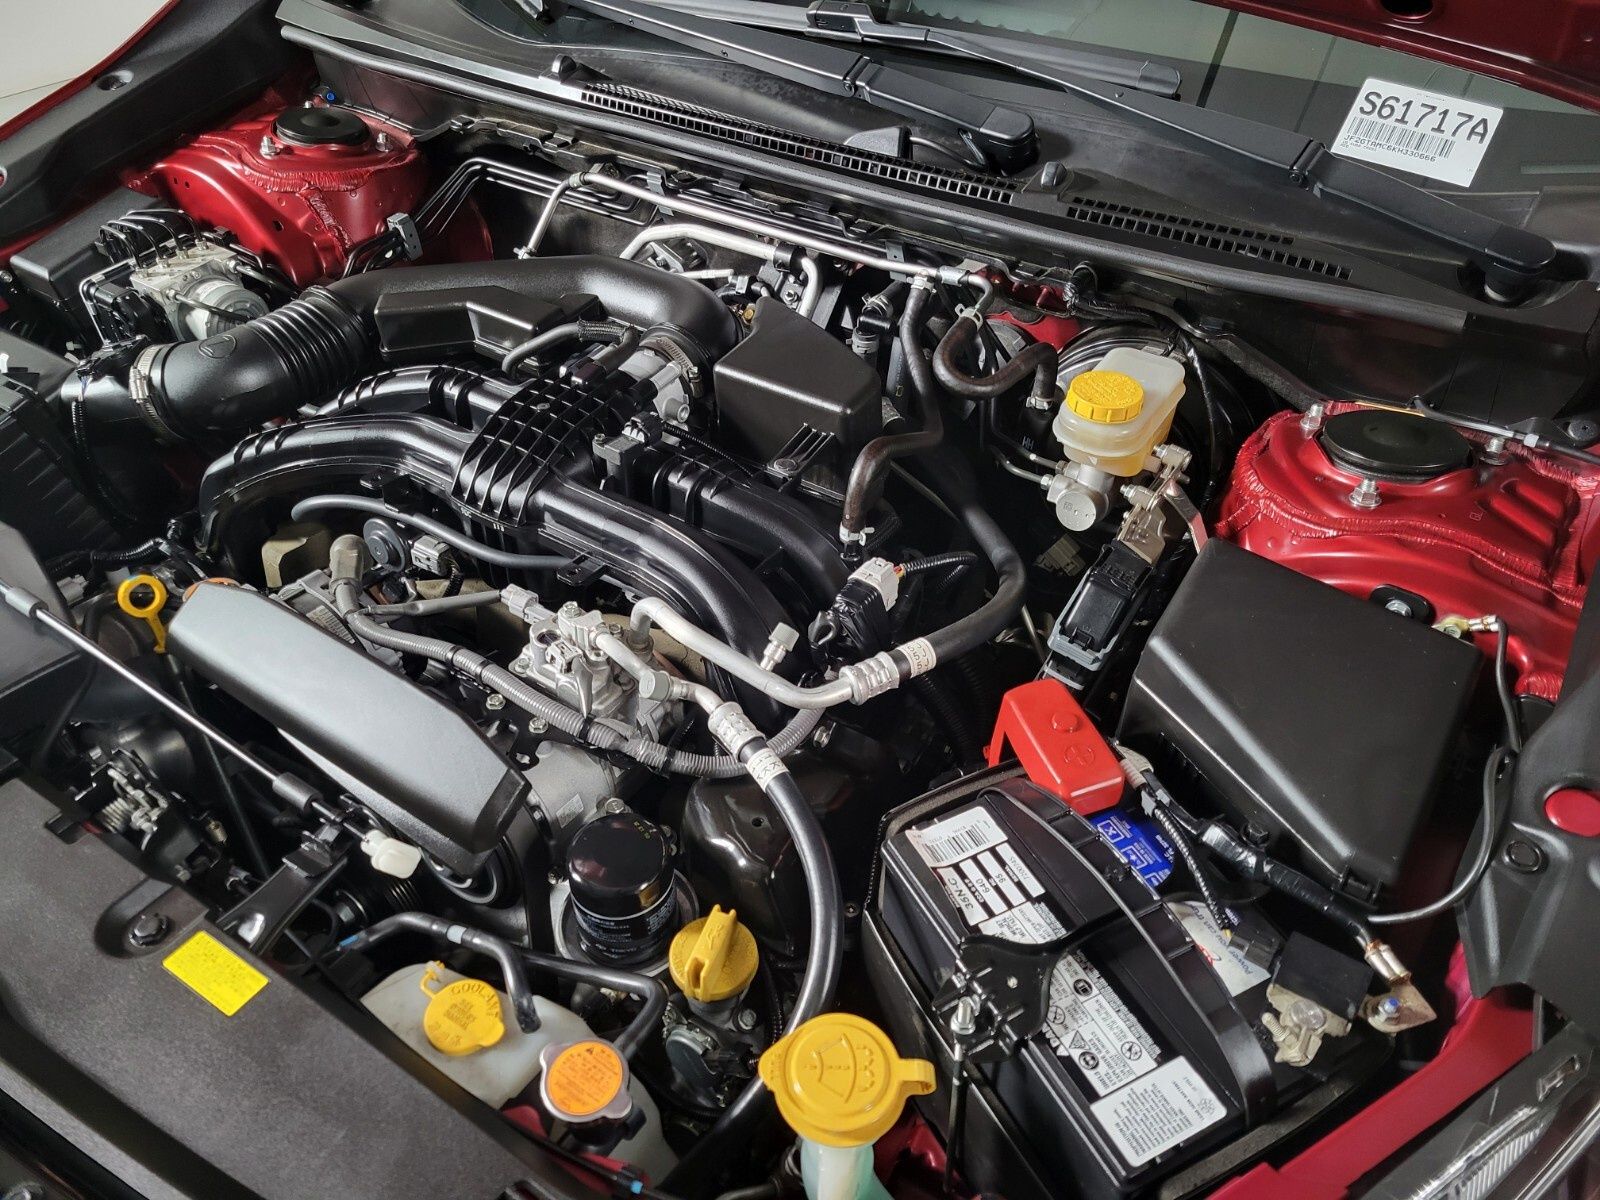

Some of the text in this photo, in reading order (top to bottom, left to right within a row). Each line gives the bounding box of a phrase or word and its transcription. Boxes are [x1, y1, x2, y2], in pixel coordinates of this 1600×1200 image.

[1359, 91, 1489, 144] S61717A
[975, 878, 990, 894] 640
[995, 873, 1006, 884] 95
[948, 878, 974, 909] 35N-C
[1203, 920, 1218, 934] can
[1229, 948, 1254, 975] Power
